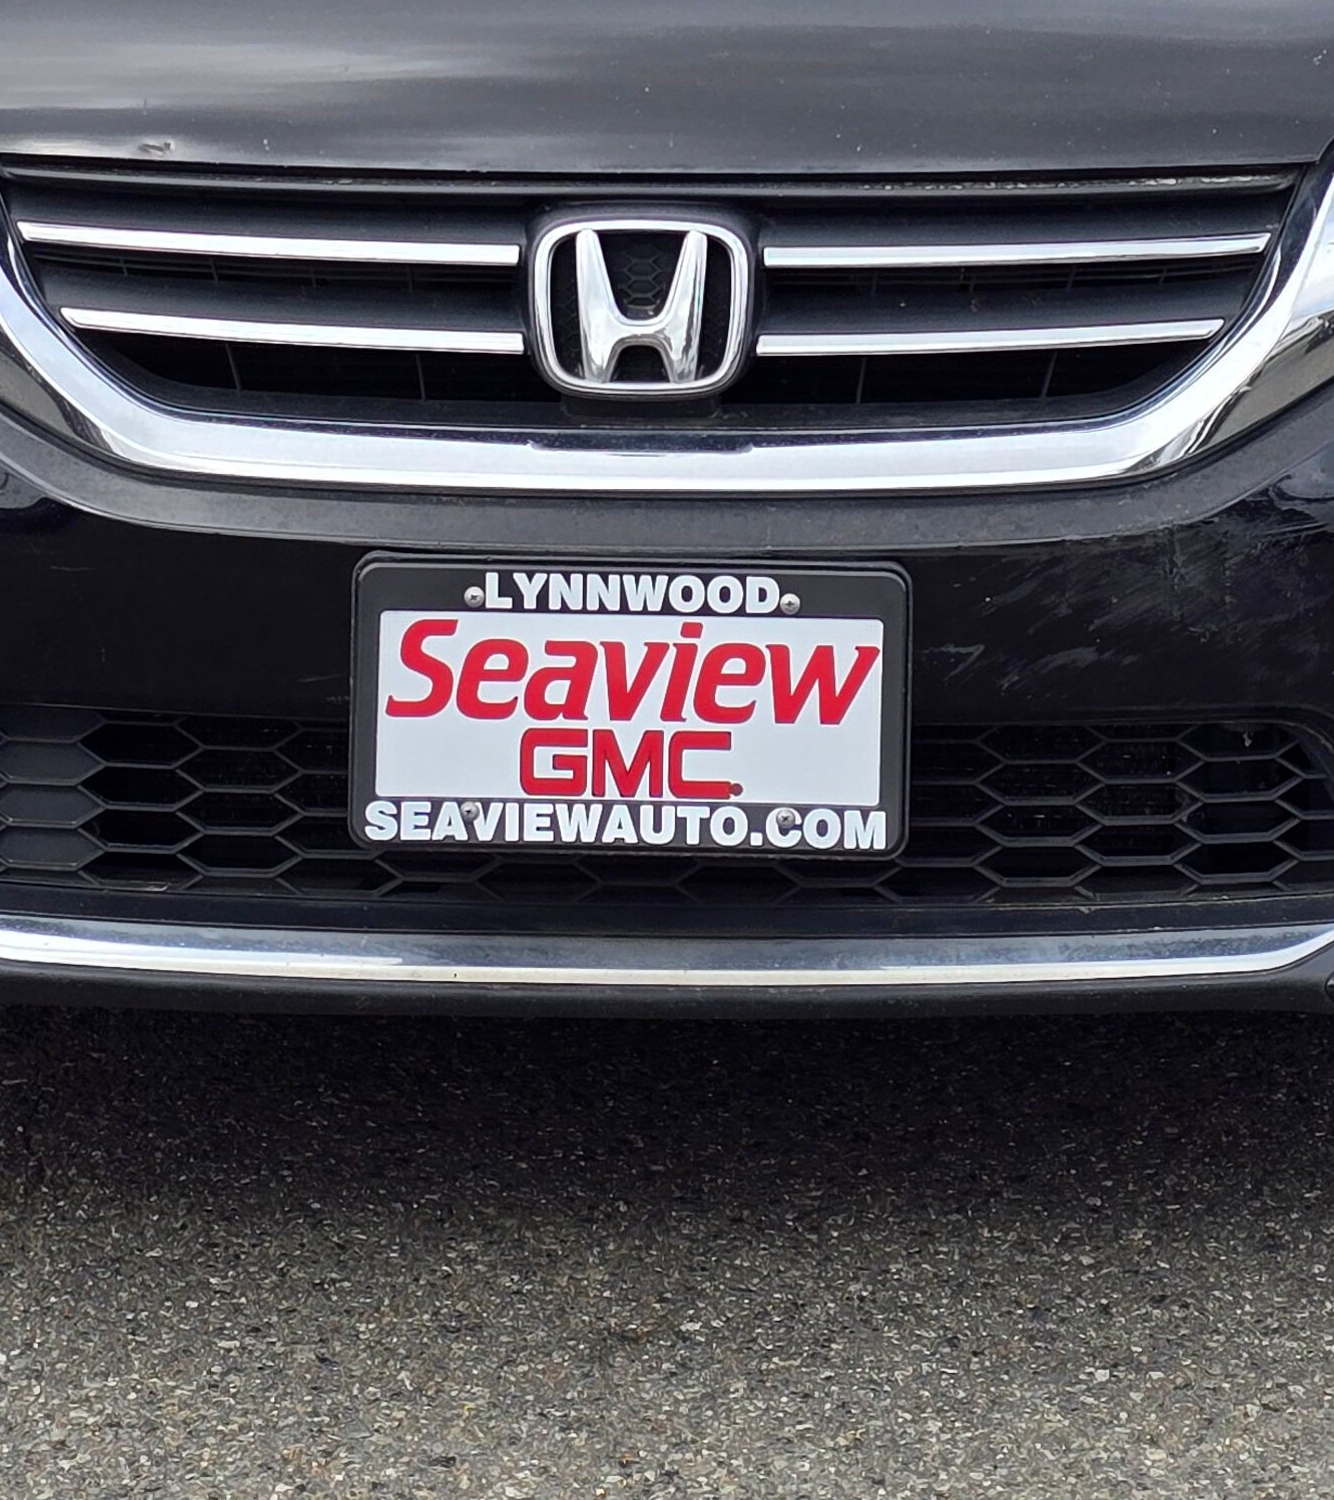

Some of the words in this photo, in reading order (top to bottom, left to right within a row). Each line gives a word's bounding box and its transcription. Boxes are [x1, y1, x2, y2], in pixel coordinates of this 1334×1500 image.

[483, 572, 779, 614] LYNNWOOD
[384, 618, 881, 725] Seaview
[519, 727, 733, 800] GMC
[363, 800, 887, 851] SEAVIEWAUTO.COM
